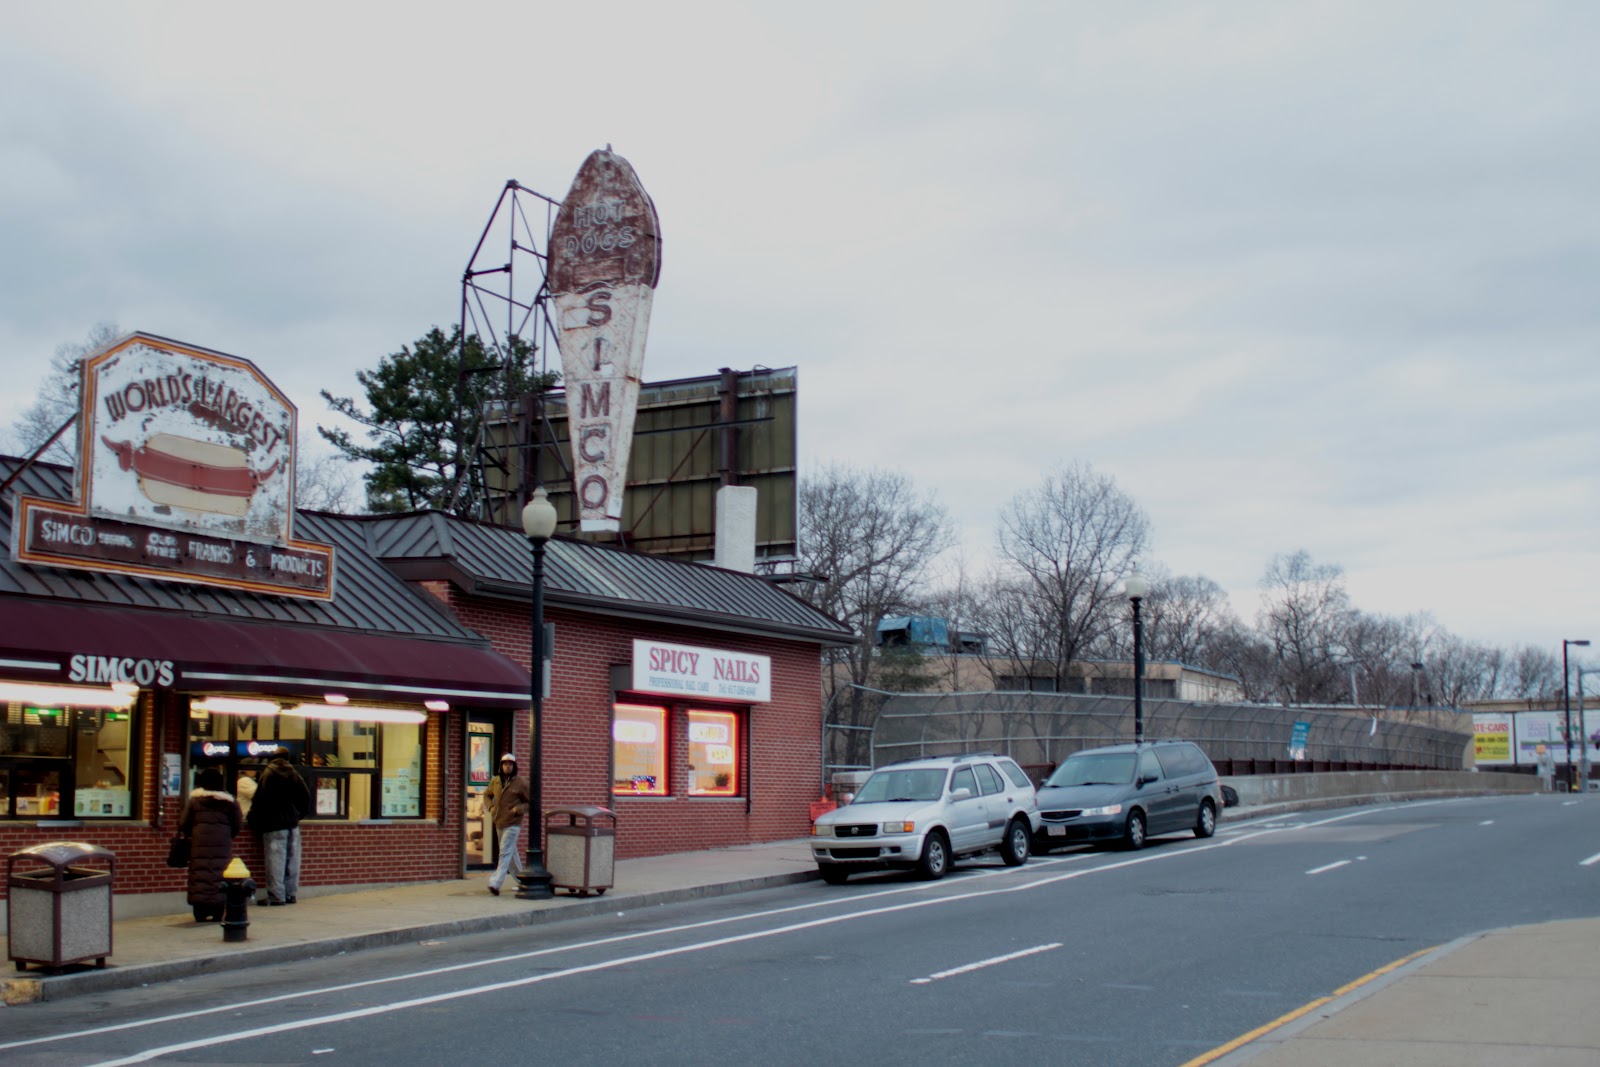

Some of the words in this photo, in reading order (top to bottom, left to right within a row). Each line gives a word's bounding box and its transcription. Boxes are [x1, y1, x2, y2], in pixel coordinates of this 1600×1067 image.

[573, 199, 626, 228] HOT
[563, 226, 637, 258] DOGS
[104, 367, 193, 422] WORLD'S
[199, 376, 282, 454] LARGEST
[580, 291, 612, 510] SIMCO
[41, 520, 96, 545] SIMCO
[188, 541, 233, 564] FRANKS
[271, 553, 323, 577] PRODUCTS
[68, 654, 174, 686] SIMCO'S
[649, 647, 699, 675] SPICY
[713, 657, 760, 684] NAILS
[471, 771, 489, 781] NAILS
